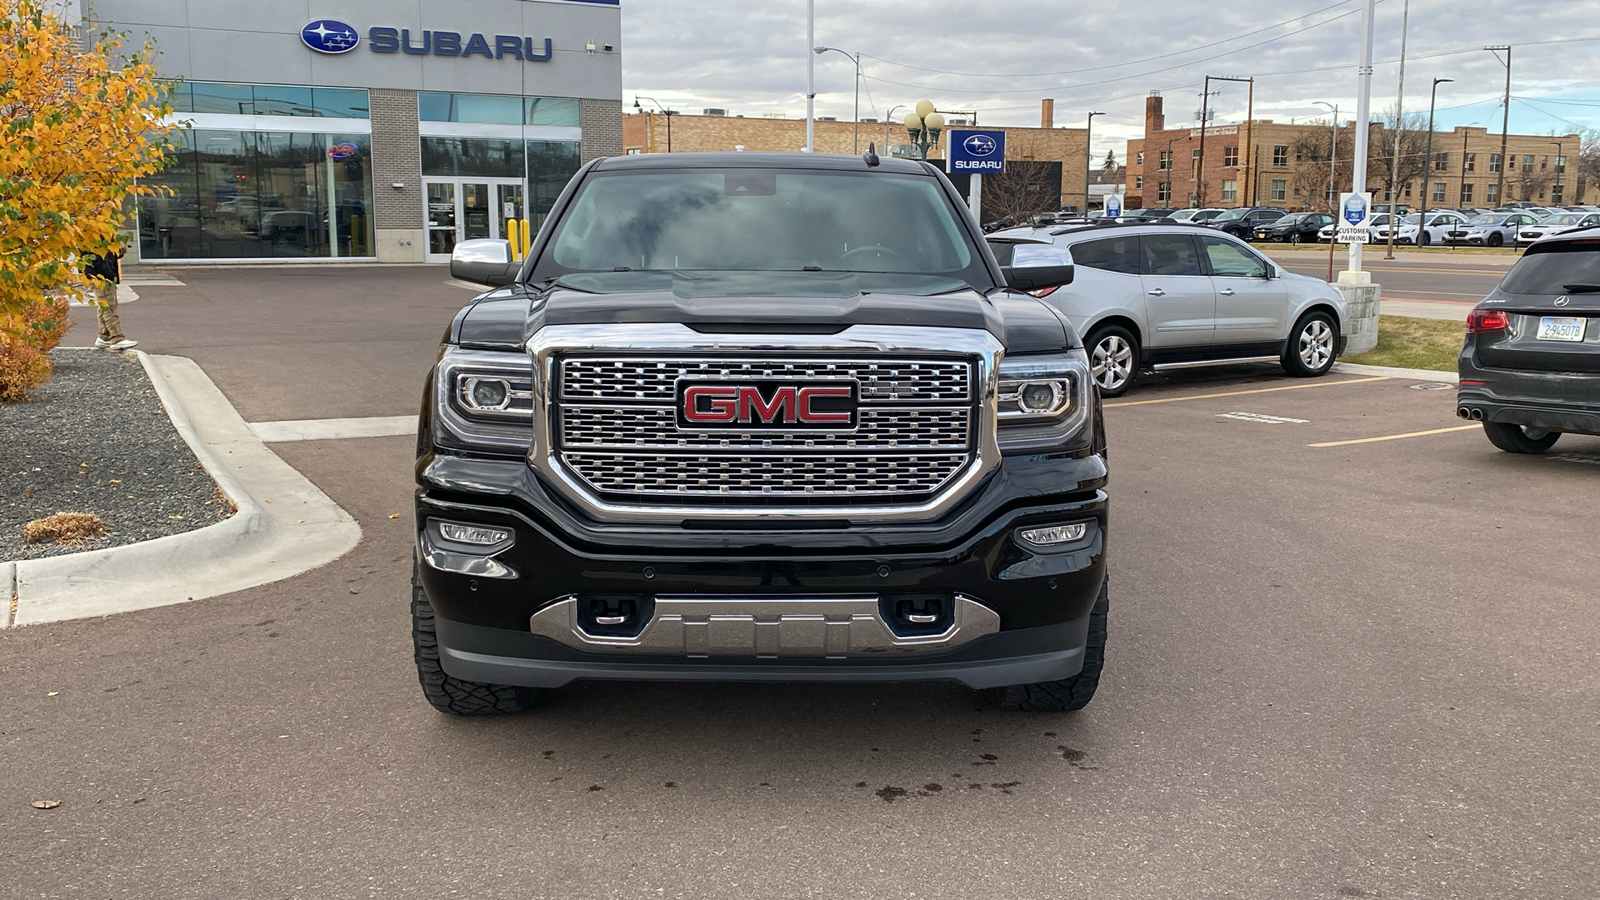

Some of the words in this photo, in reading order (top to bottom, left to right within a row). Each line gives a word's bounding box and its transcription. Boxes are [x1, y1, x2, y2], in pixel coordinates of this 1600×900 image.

[369, 26, 552, 62] SUBARU
[955, 160, 1002, 169] SUBARU
[684, 386, 851, 423] GMC
